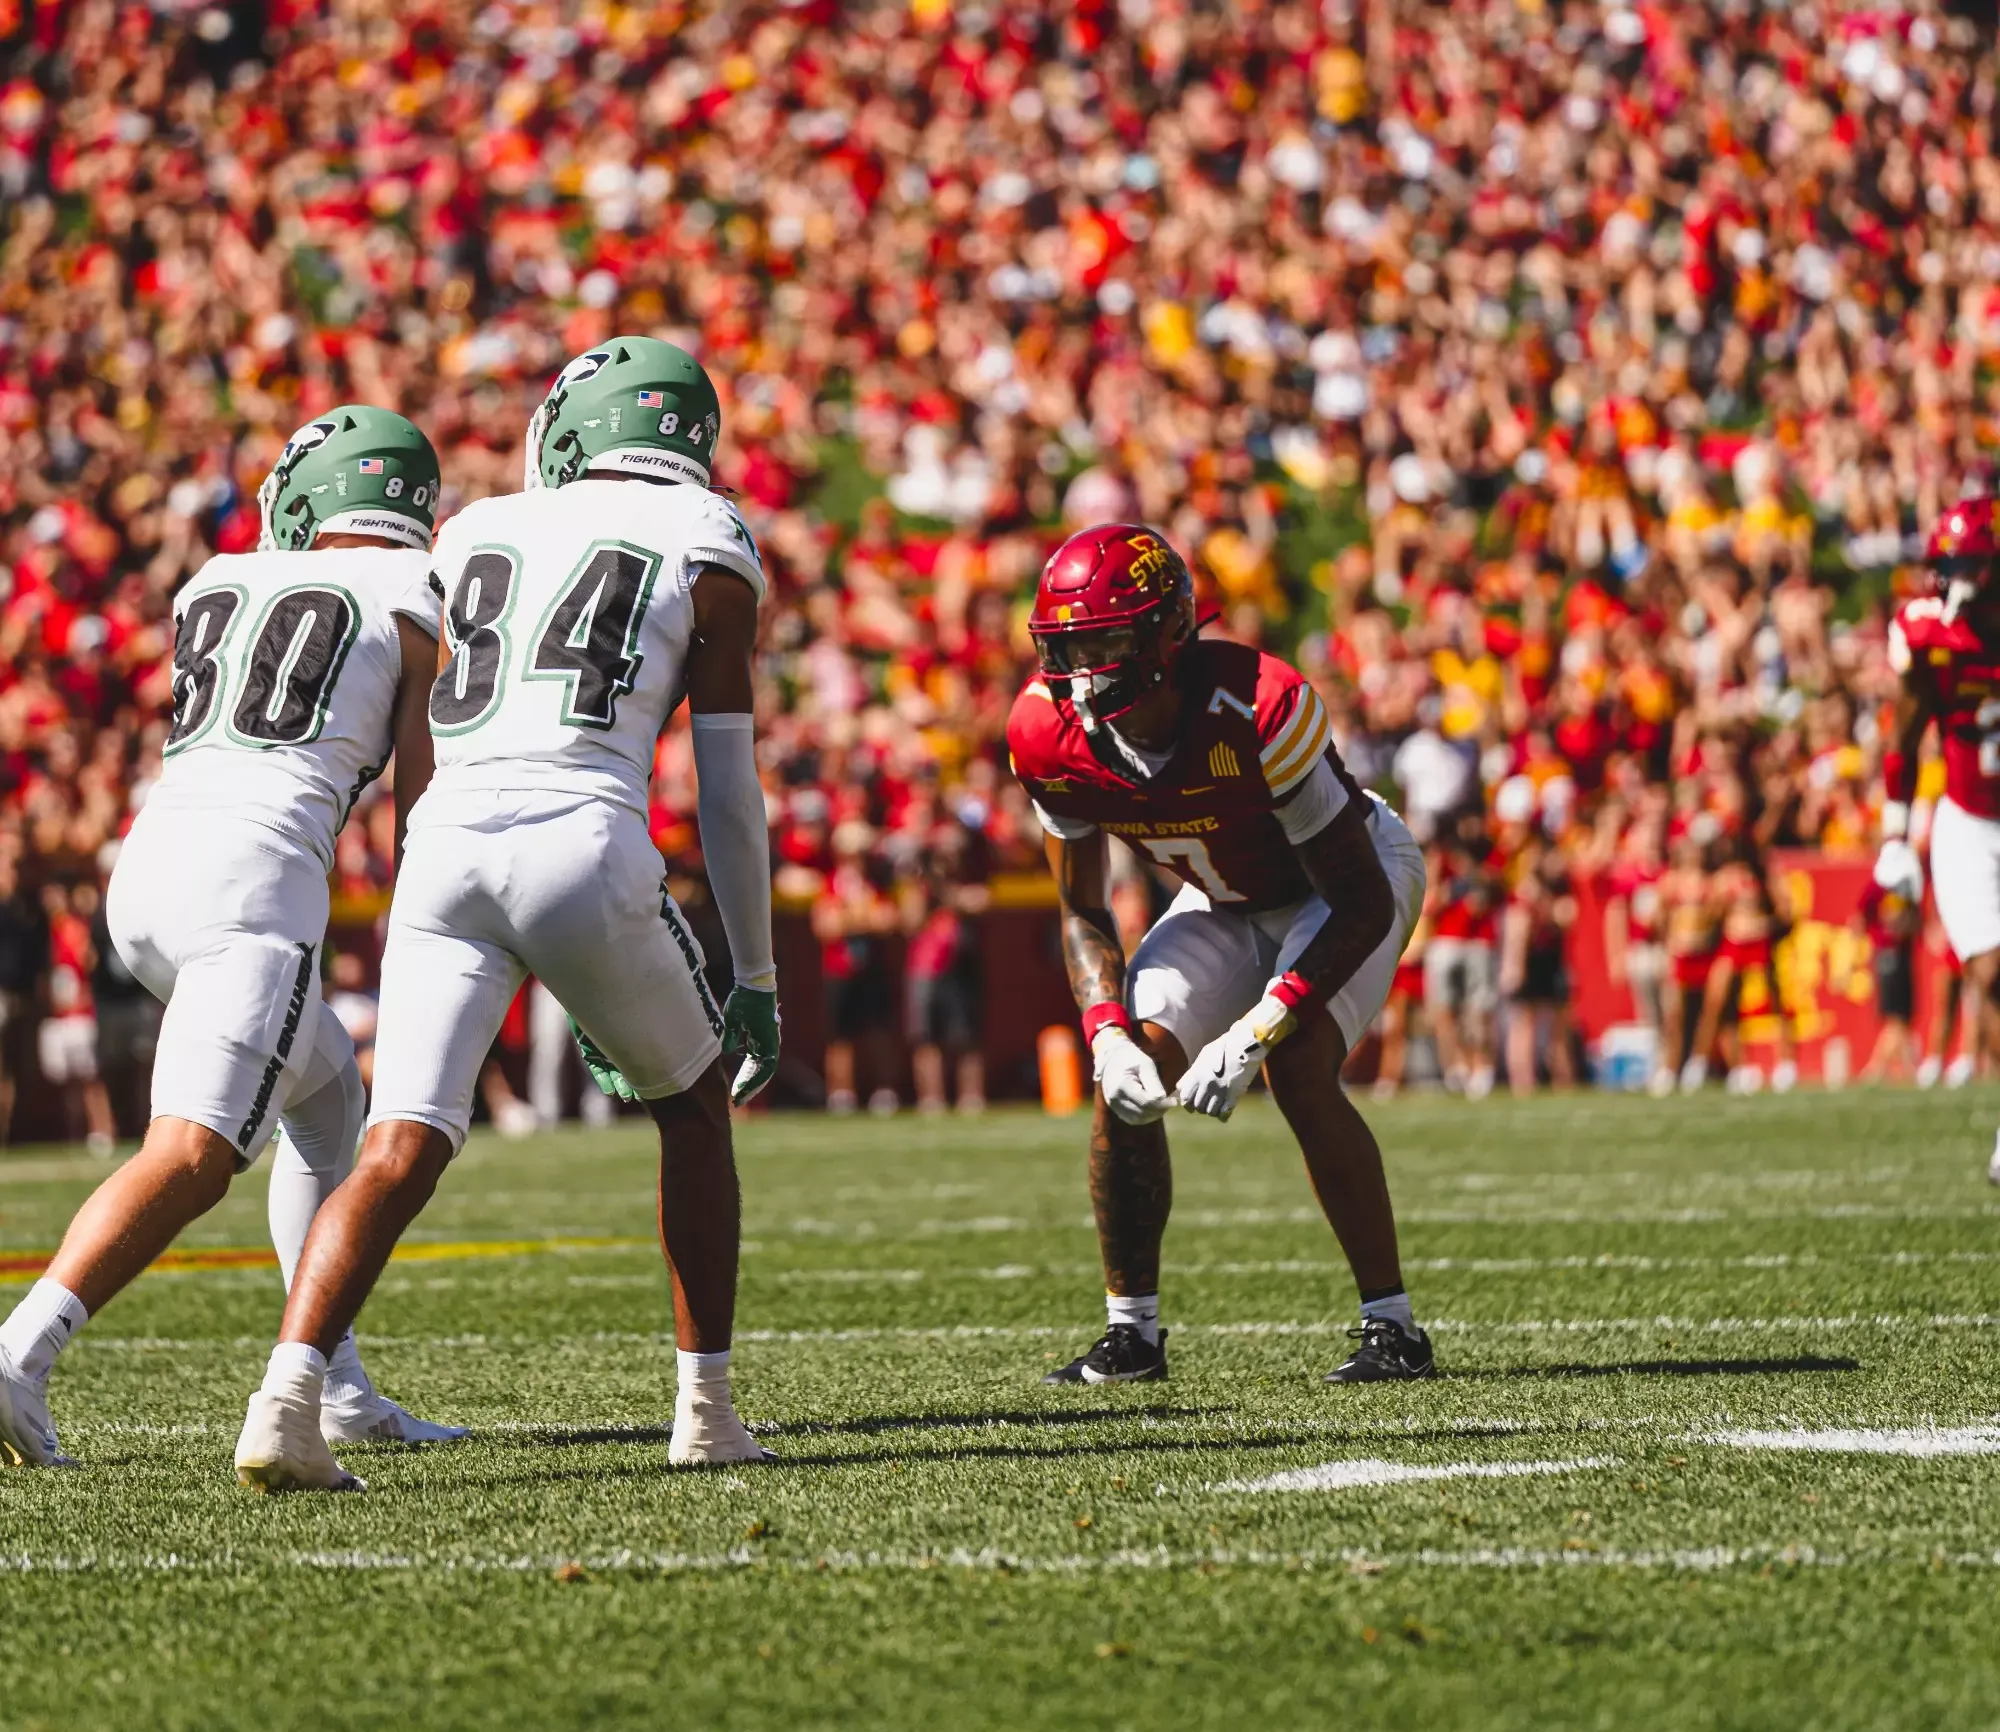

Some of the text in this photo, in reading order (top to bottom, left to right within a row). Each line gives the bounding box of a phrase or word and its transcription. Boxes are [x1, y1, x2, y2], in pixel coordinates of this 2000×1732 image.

[658, 412, 703, 445] 84
[620, 454, 708, 488] FIGHTING HAWKS
[385, 477, 428, 507] 80
[350, 518, 406, 532] FIGHTING
[428, 539, 664, 738] 84
[163, 583, 363, 758] 80
[1207, 686, 1254, 721] 7
[1154, 816, 1219, 835] STATE
[1138, 837, 1249, 902] 7
[237, 942, 317, 1152] FIGHTING HAWKS
